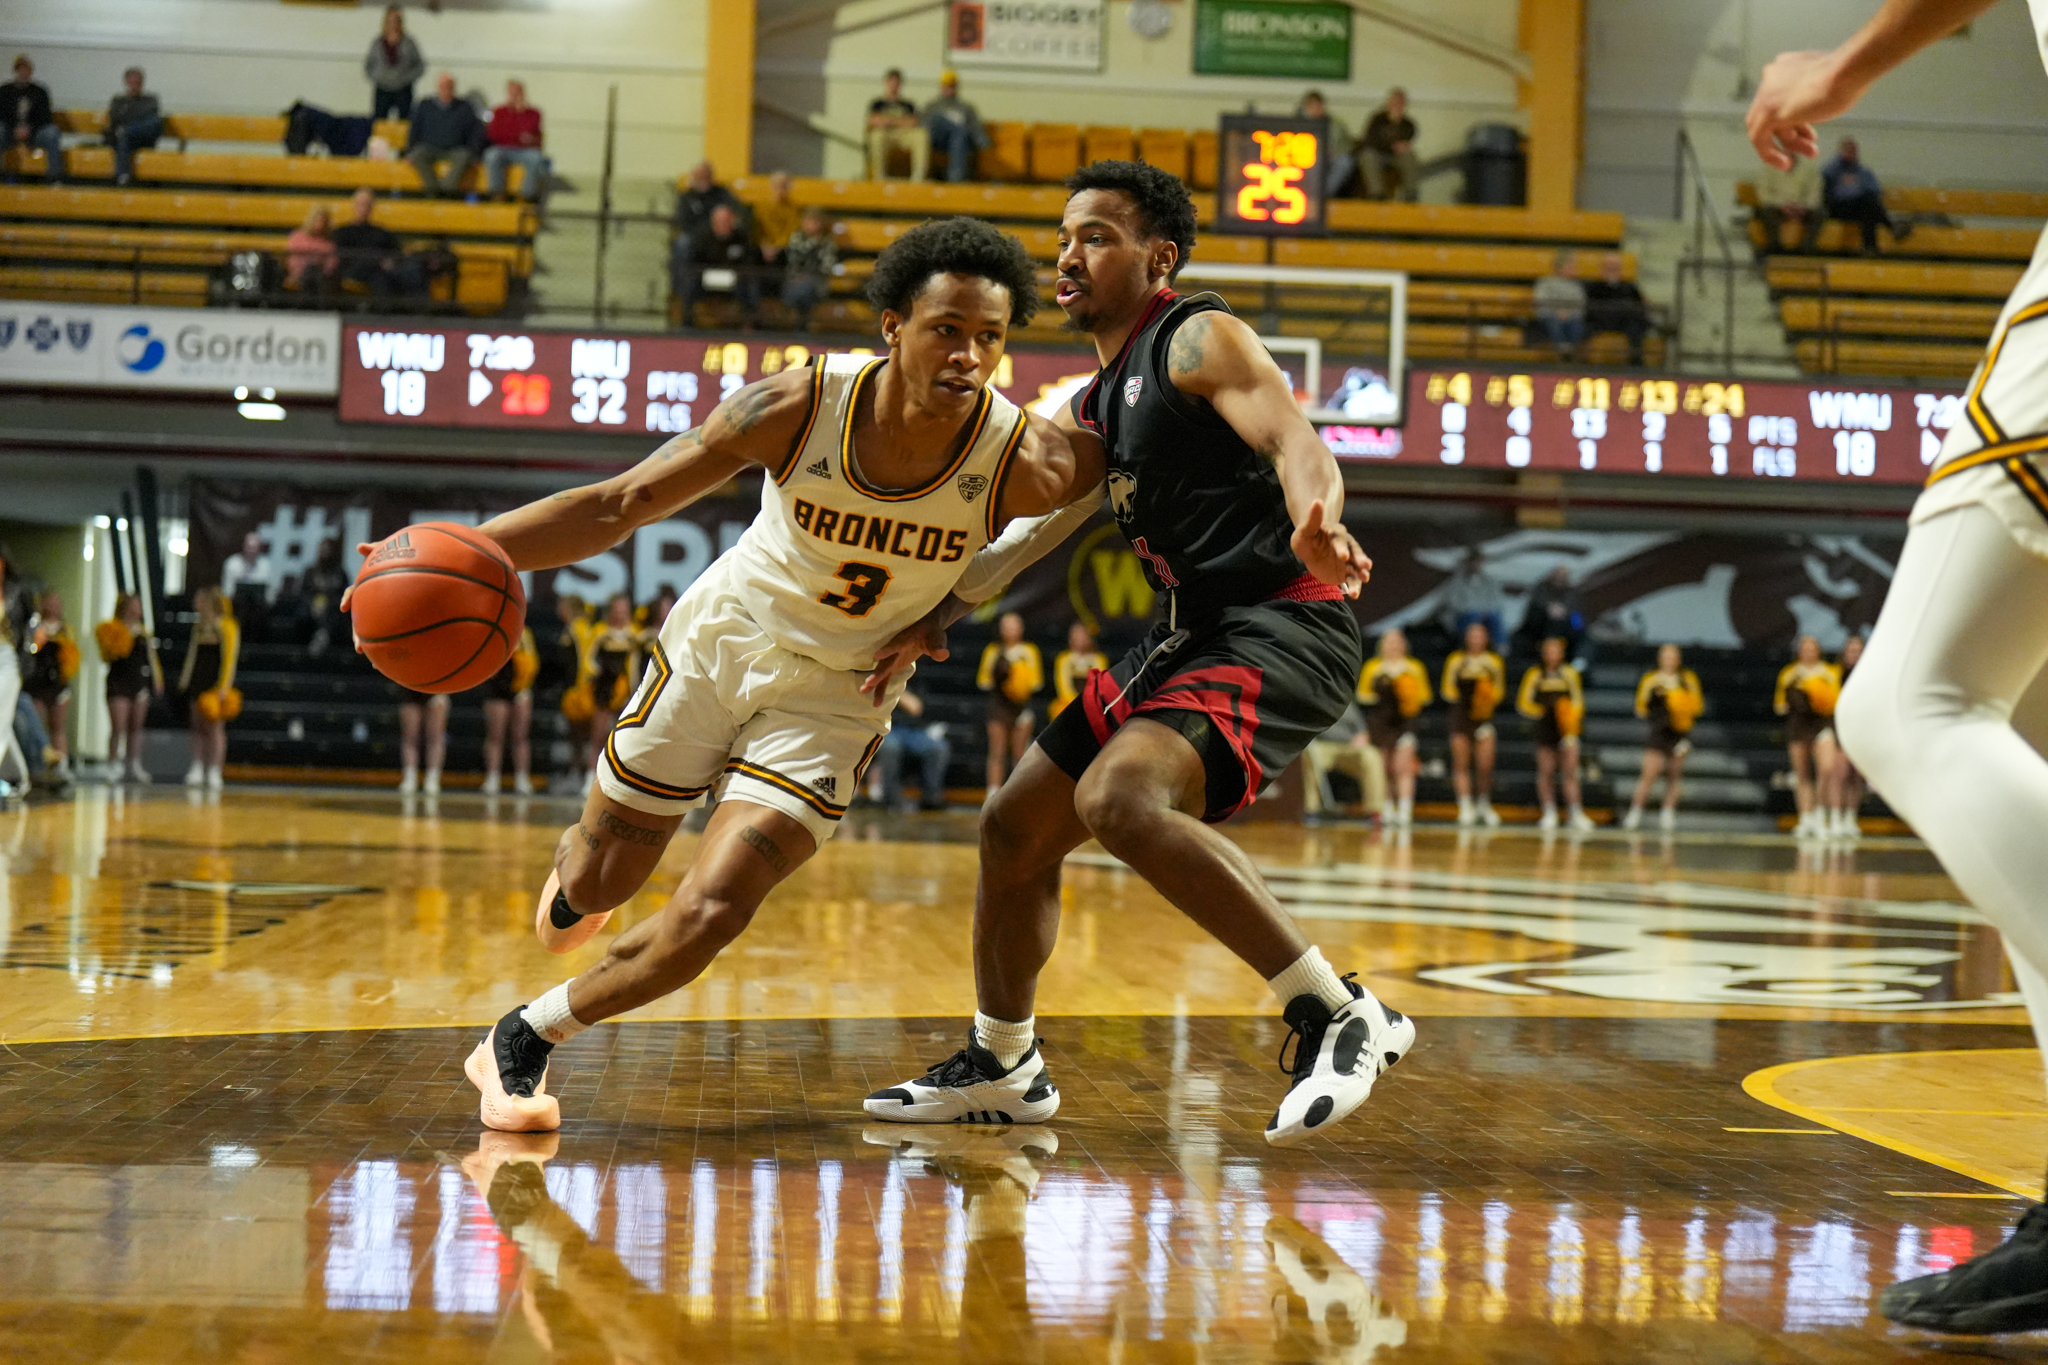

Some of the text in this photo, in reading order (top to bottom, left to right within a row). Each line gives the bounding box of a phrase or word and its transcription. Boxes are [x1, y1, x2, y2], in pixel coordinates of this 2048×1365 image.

[1237, 163, 1307, 223] 25
[175, 324, 327, 366] Gordon
[358, 331, 445, 371] WMU
[381, 369, 426, 416] 18
[571, 378, 627, 424] 32
[1426, 372, 1472, 406] #4
[1808, 391, 1892, 431] WMU
[807, 467, 832, 480] adidas
[1578, 438, 1598, 470] 1
[1643, 441, 1663, 473] 1
[1710, 444, 1728, 476] 1
[1833, 430, 1876, 476] 18
[793, 497, 968, 563] BRONCOS
[817, 560, 894, 618] 3
[812, 778, 836, 800] adidas
